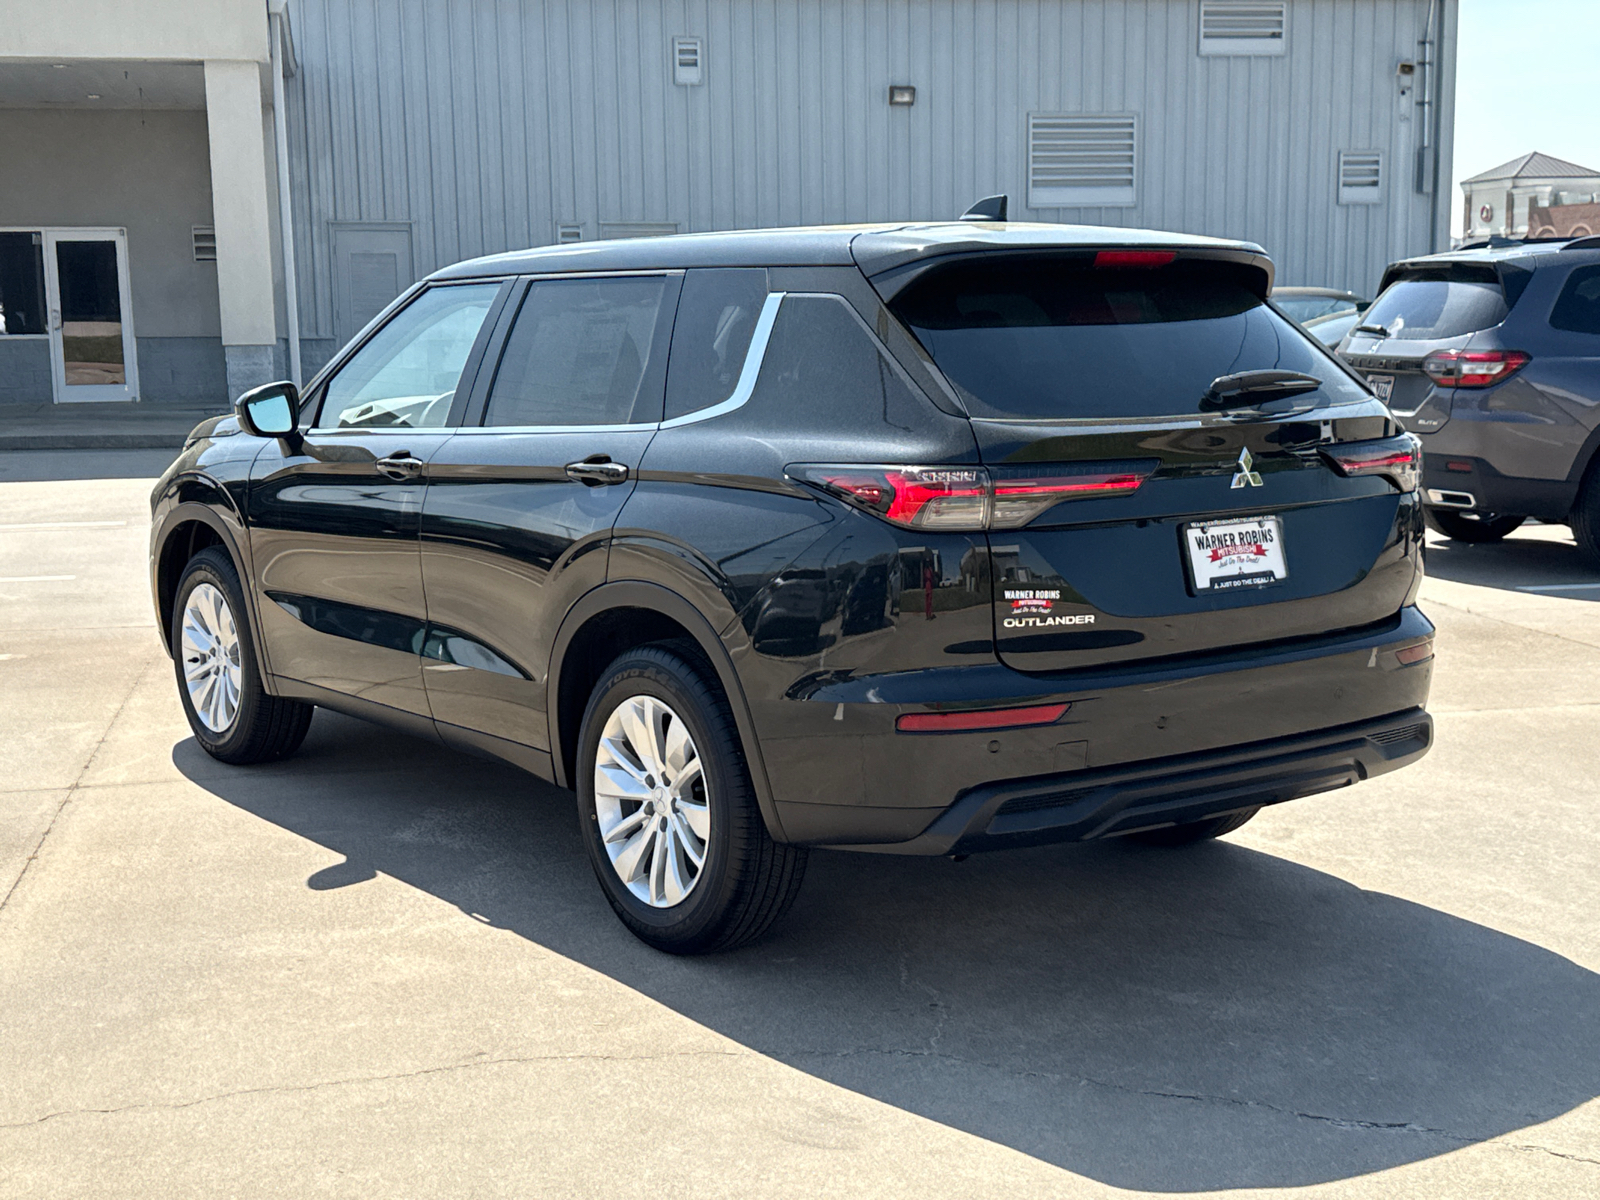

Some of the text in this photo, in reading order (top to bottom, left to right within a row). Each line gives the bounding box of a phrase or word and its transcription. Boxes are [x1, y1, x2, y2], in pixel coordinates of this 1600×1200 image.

[1195, 528, 1274, 551] WARNER ROBINS
[1217, 545, 1257, 557] MITSUBISHI
[1219, 580, 1233, 589] JUST
[1242, 578, 1253, 586] THE
[1253, 576, 1269, 584] DEAL!
[1004, 590, 1060, 599] WARNER ROBINS
[1003, 614, 1095, 628] OUTLANDER
[607, 667, 640, 688] TOYO
